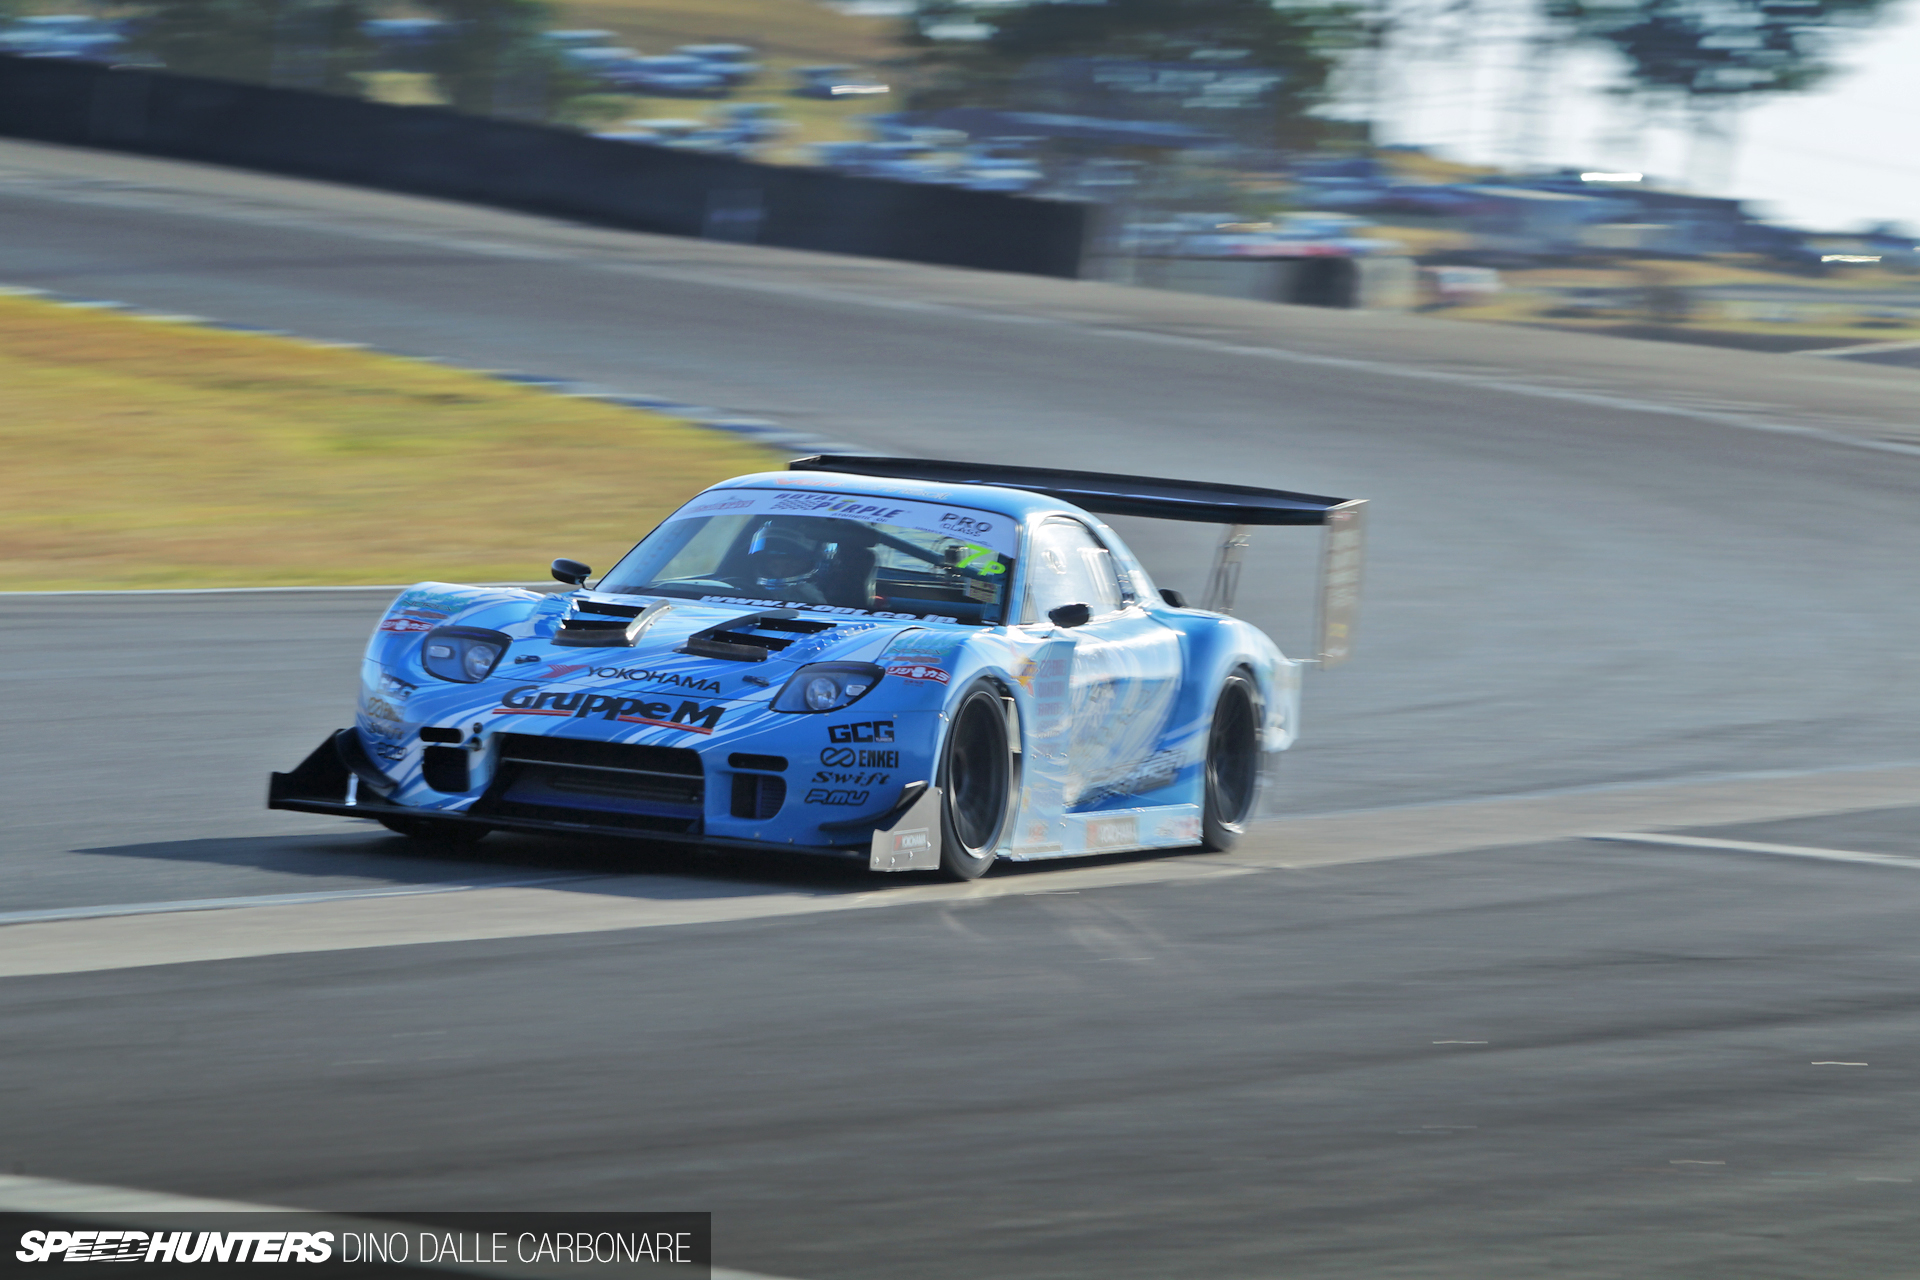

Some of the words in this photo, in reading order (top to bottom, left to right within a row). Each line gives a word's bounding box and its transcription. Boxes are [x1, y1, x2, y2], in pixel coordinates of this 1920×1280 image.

[773, 493, 839, 501] ROYAL
[812, 500, 904, 519] PURPLE
[940, 512, 992, 532] PRO
[940, 523, 981, 537] CLASS
[700, 595, 958, 624] www.v-opt.co.jp
[588, 666, 721, 693] YOKOHAMA
[501, 685, 727, 730] GruppeM
[827, 720, 895, 743] GCG
[858, 749, 899, 768] ENKEI
[812, 770, 890, 786] Swift
